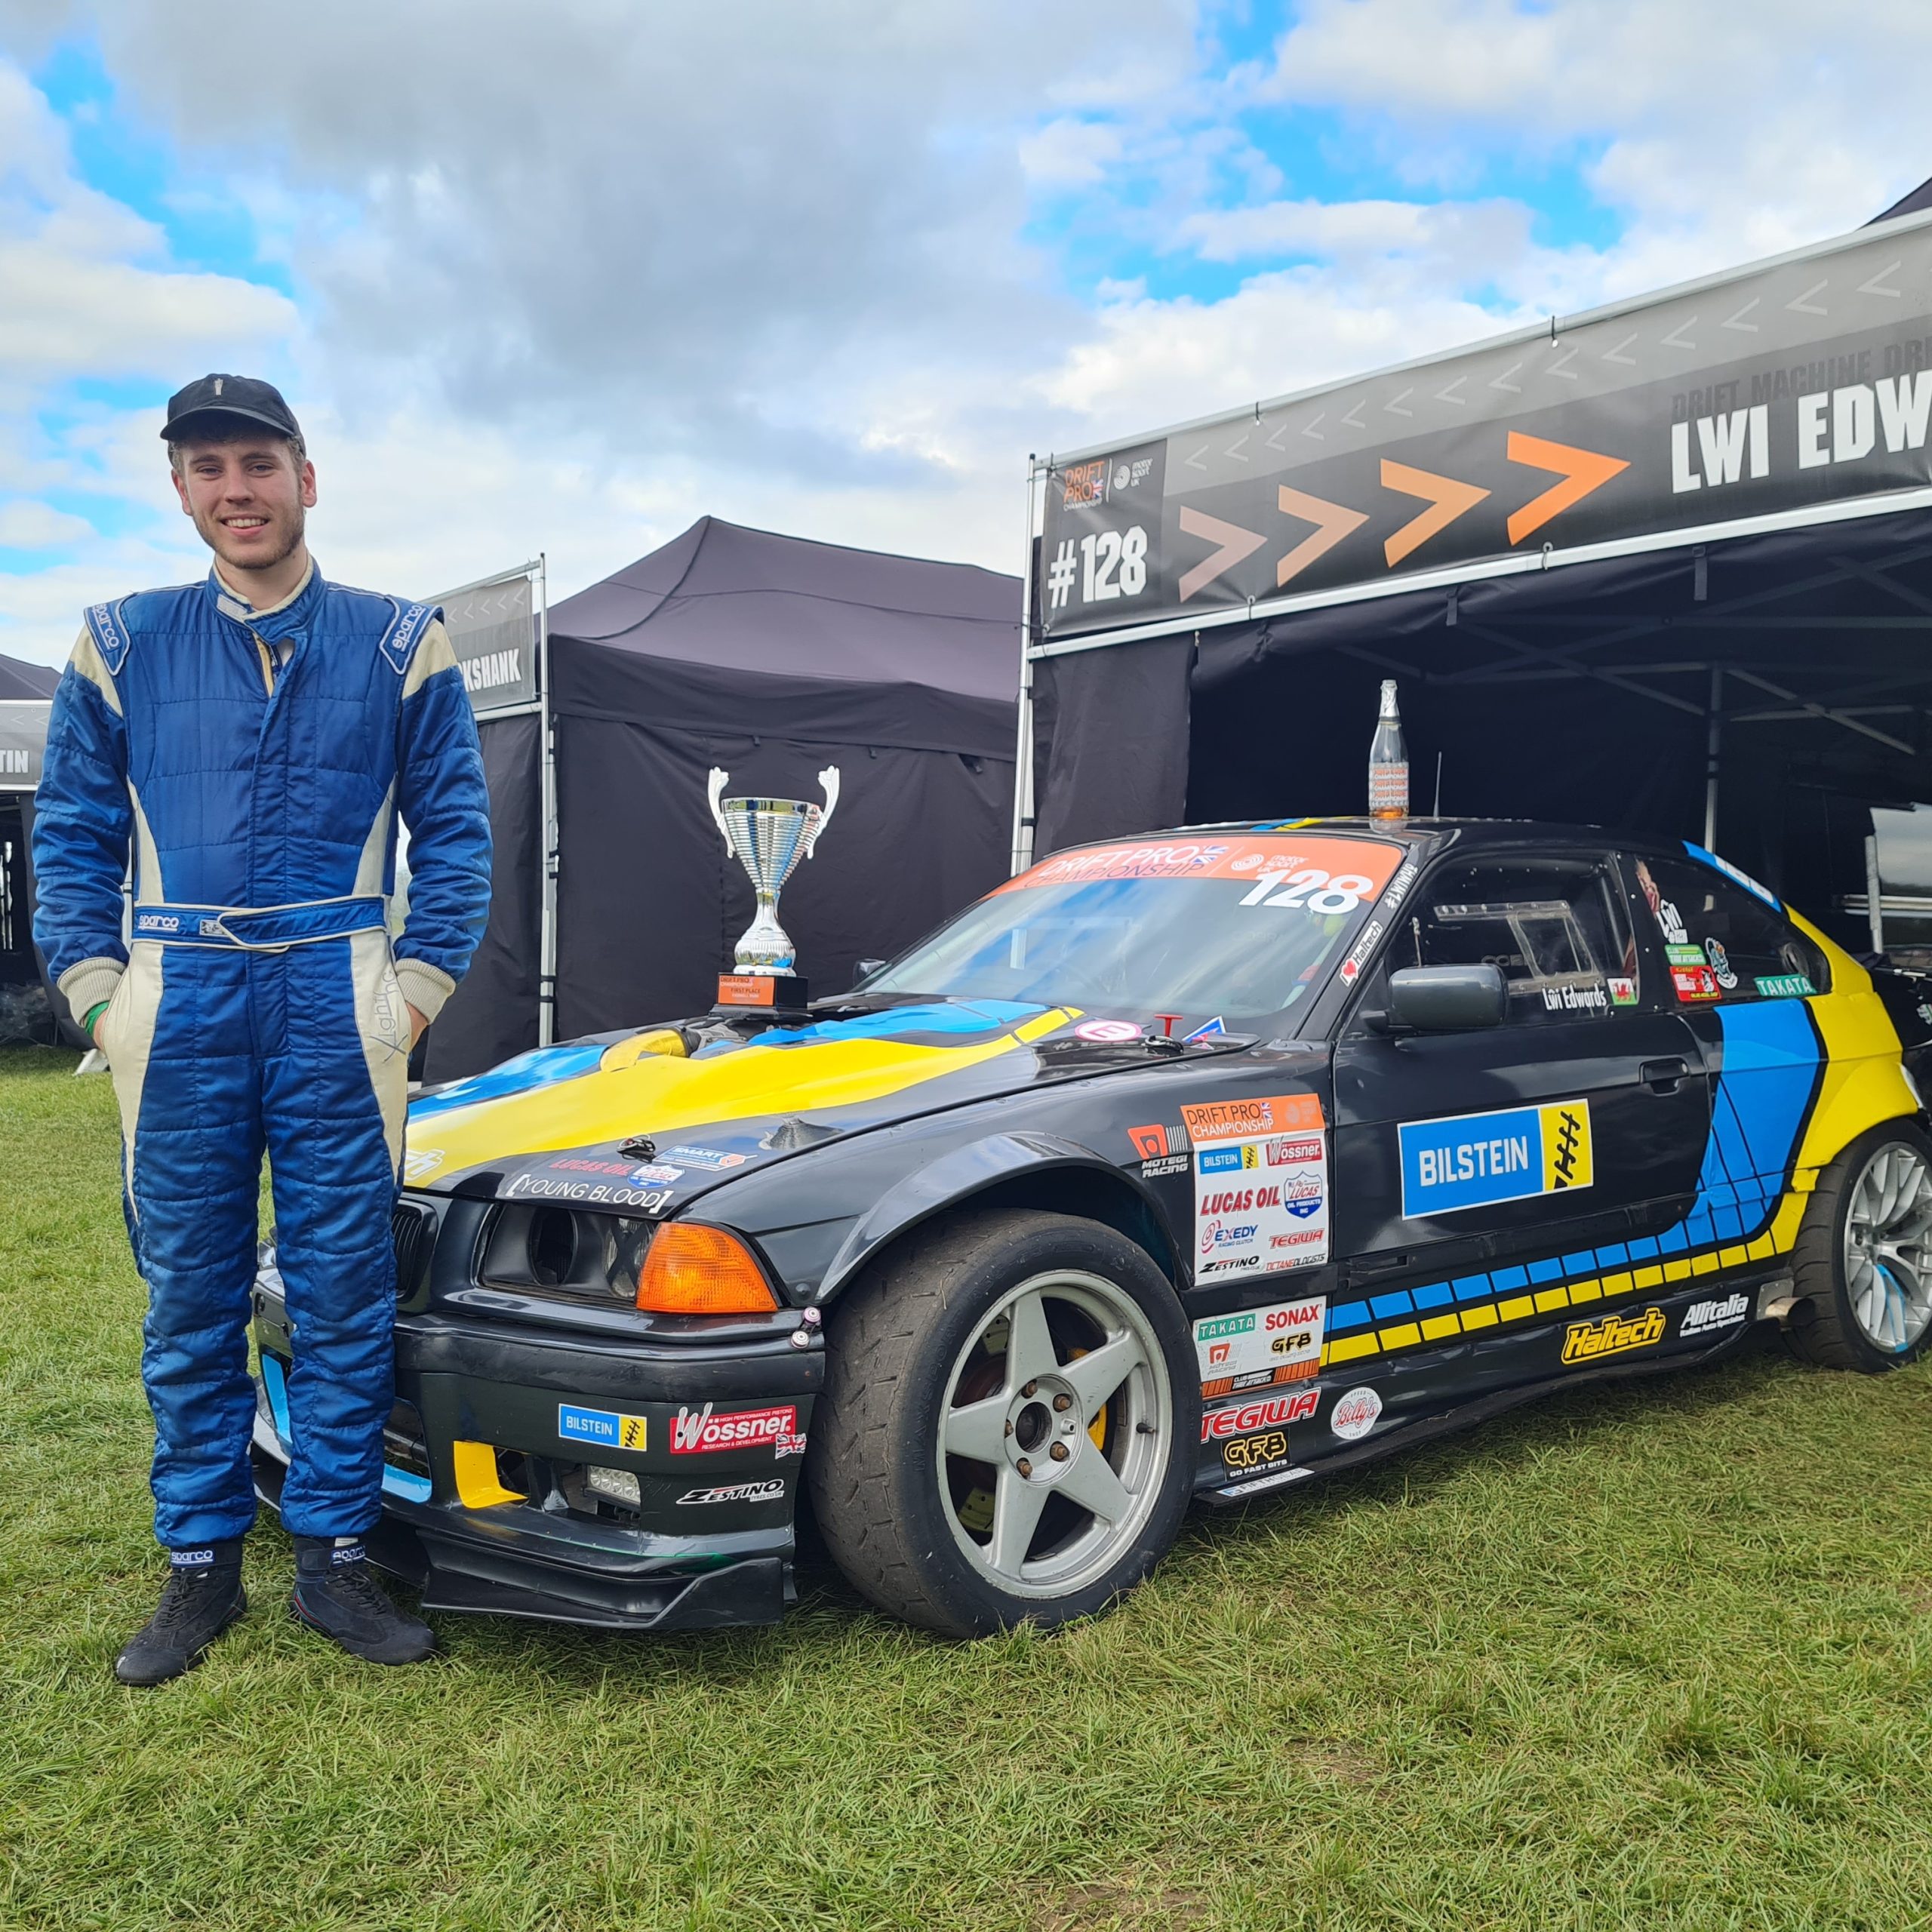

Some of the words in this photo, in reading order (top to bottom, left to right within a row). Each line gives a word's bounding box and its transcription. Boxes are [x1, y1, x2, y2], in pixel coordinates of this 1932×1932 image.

[1672, 404, 1770, 494] LWI
[1064, 460, 1106, 487] DRIFT
[1063, 481, 1094, 503] PRO
[1047, 525, 1149, 608] #128
[392, 605, 424, 650] sparco
[458, 648, 521, 692] KSHANK
[1038, 850, 1132, 877] DRIFT
[1125, 845, 1199, 865] PRO
[1238, 869, 1374, 915] 128
[139, 915, 180, 931] sparco
[1352, 922, 1383, 967] Haltech
[1561, 983, 1607, 1009] Edwards
[1757, 977, 1813, 995] TAKATA
[1186, 1106, 1226, 1124] DRIFT
[1230, 1103, 1260, 1121] PRO
[1193, 1118, 1274, 1137] CHAMPIONSHIP
[672, 1147, 724, 1159] SMART
[1142, 1155, 1188, 1169] MOTEGI
[1204, 1153, 1238, 1168] BILSTEIN
[1419, 1136, 1529, 1187] BILSTEIN
[549, 1158, 604, 1172] LUCAS
[601, 1162, 635, 1177] OIL
[1143, 1163, 1188, 1178] RACING
[1200, 1189, 1254, 1216] LUCAS
[1257, 1186, 1280, 1208] OIL
[1289, 1185, 1320, 1199] LUCAS
[1215, 1225, 1259, 1241] EXEDY
[1269, 1229, 1324, 1248] TEGIWA
[1198, 1256, 1260, 1273] ZESTINO
[1266, 1304, 1319, 1331] SONAX
[1681, 1293, 1749, 1329] Allitalia
[1201, 1317, 1254, 1337] TAKATA
[1564, 1312, 1666, 1359] Haltech
[1272, 1331, 1312, 1353] GFB
[1201, 1390, 1320, 1442] TEGIWA
[1334, 1397, 1379, 1429] Billy's
[566, 1415, 613, 1436] BILSTEIN
[736, 1435, 773, 1446] DEVELOPMENT
[1224, 1431, 1287, 1466] GFB
[1244, 1463, 1266, 1475] FAST
[1268, 1459, 1288, 1469] BITS
[677, 1479, 783, 1503] ZESTINO
[171, 1550, 214, 1561] sparco
